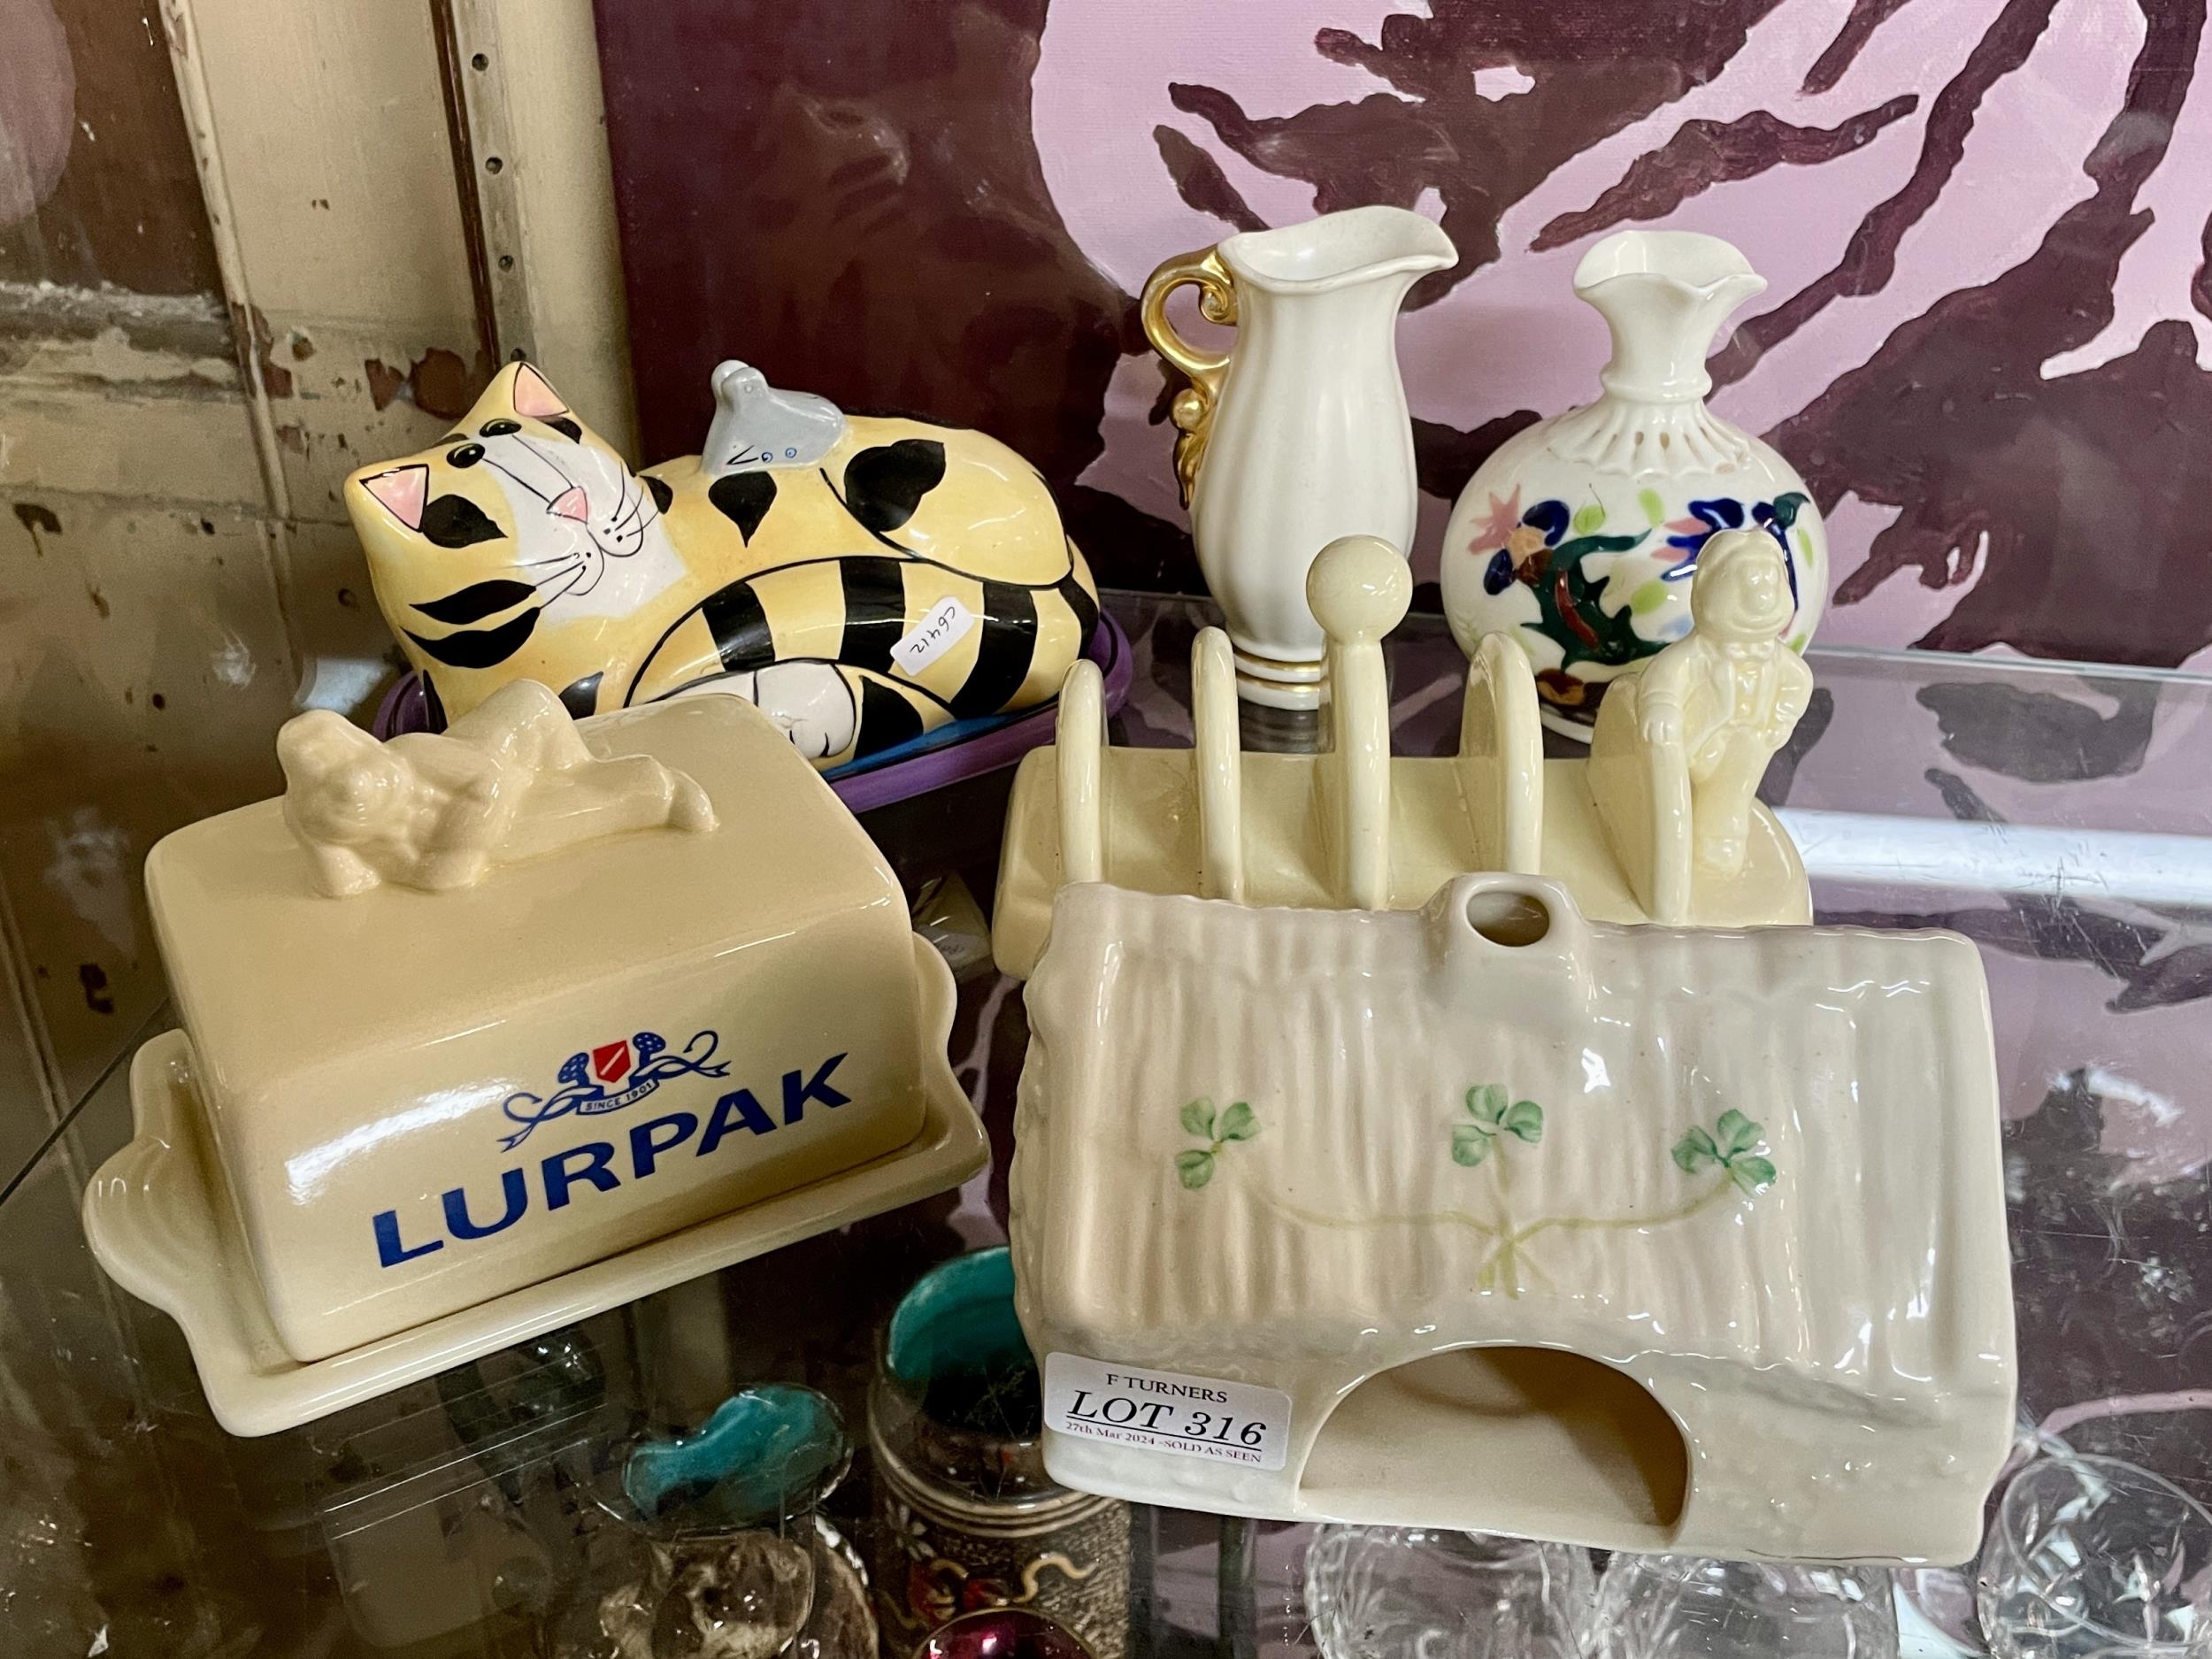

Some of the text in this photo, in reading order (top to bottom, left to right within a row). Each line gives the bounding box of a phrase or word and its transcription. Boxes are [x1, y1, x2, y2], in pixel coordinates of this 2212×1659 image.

[586, 1081, 653, 1111] SINCE 1901
[373, 1052, 852, 1268] LURPAK
[1106, 1372, 1228, 1403] F TURNERS
[1067, 1389, 1267, 1446] LOT 316
[1064, 1421, 1094, 1435] 27th
[1096, 1426, 1122, 1440] Mar
[1125, 1432, 1156, 1446] 2024
[1204, 1446, 1224, 1457] AS
[1226, 1450, 1262, 1463] SEEN
